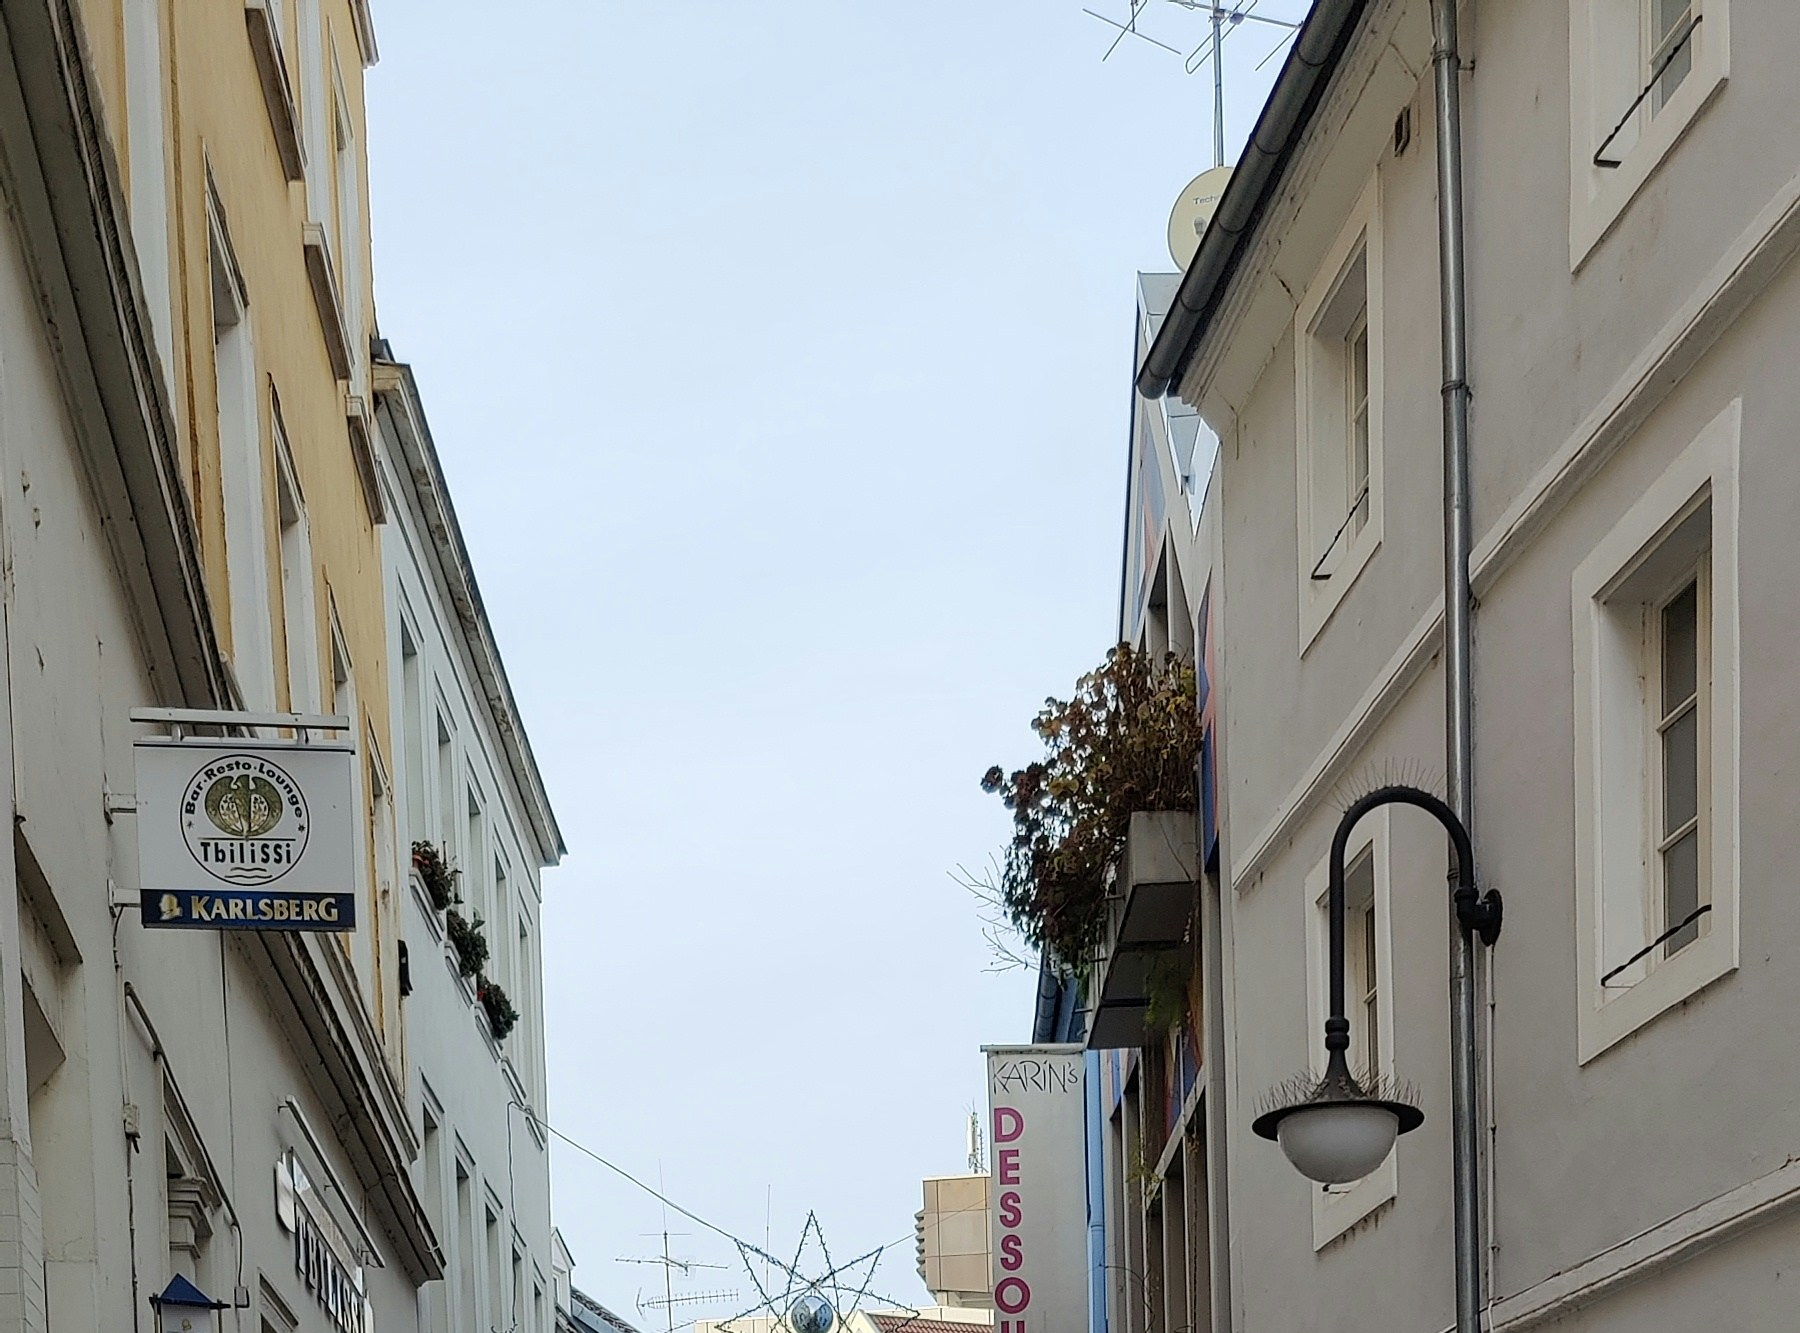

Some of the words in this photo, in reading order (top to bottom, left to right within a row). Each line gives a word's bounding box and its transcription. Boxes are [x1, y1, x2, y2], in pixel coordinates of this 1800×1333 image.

[185, 780, 204, 815] Bar
[204, 760, 252, 781] Resto
[258, 763, 303, 818] Lounge
[191, 896, 338, 922] KARLSBERG
